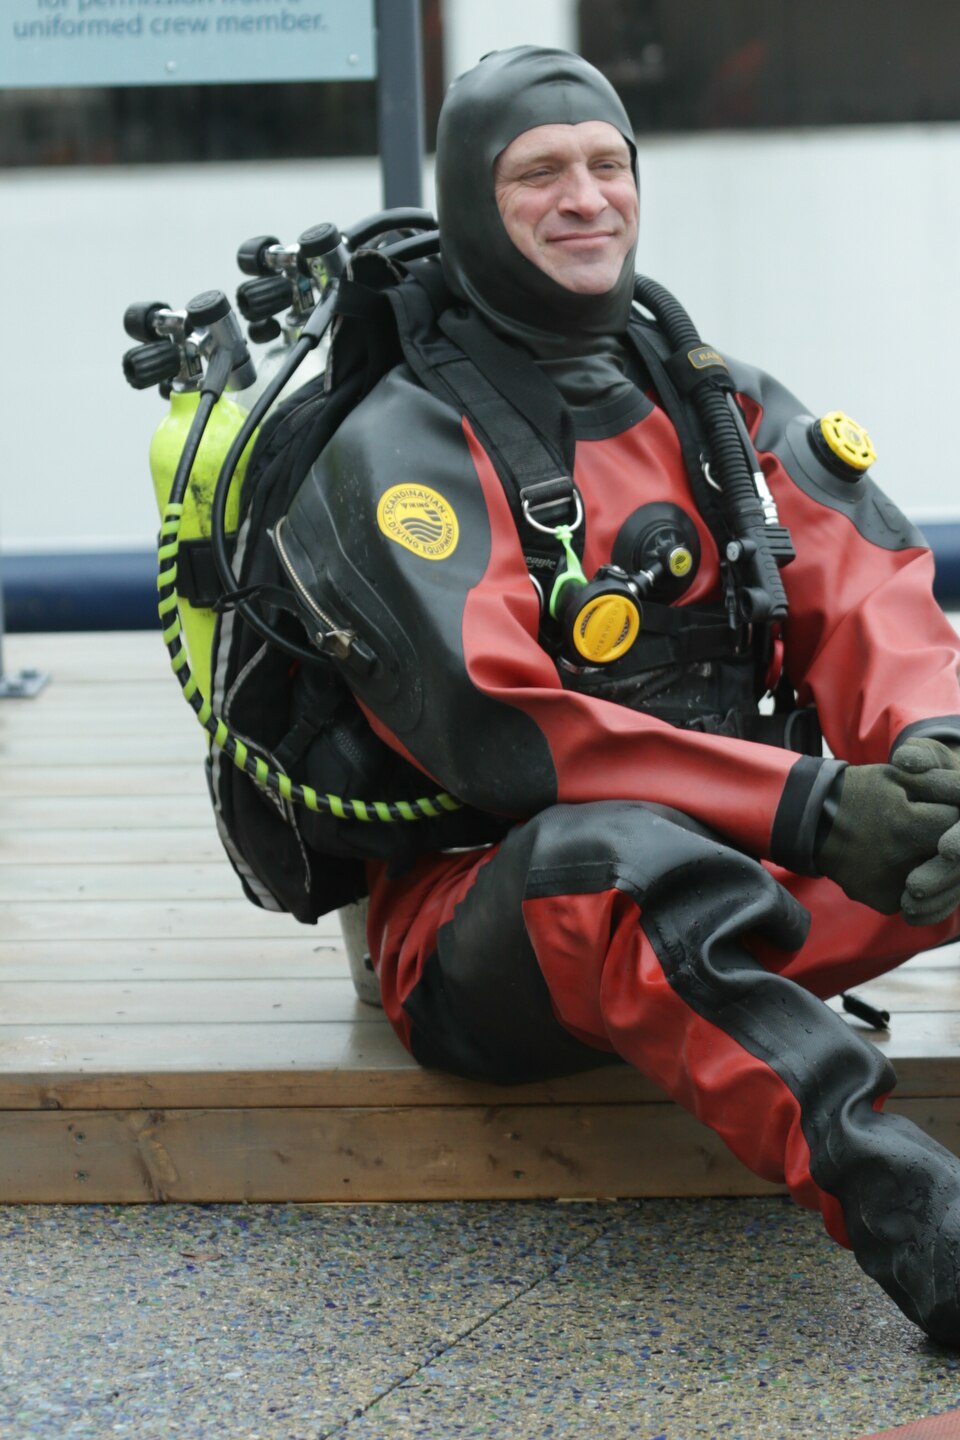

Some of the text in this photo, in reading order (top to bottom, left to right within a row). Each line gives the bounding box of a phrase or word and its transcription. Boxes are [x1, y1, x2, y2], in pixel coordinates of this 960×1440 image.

[13, 10, 328, 40] uniformed crew member.
[384, 489, 446, 515] SCANDINAVIAN
[400, 501, 430, 509] VIKING
[388, 521, 453, 554] DIVING EQUIPMENT
